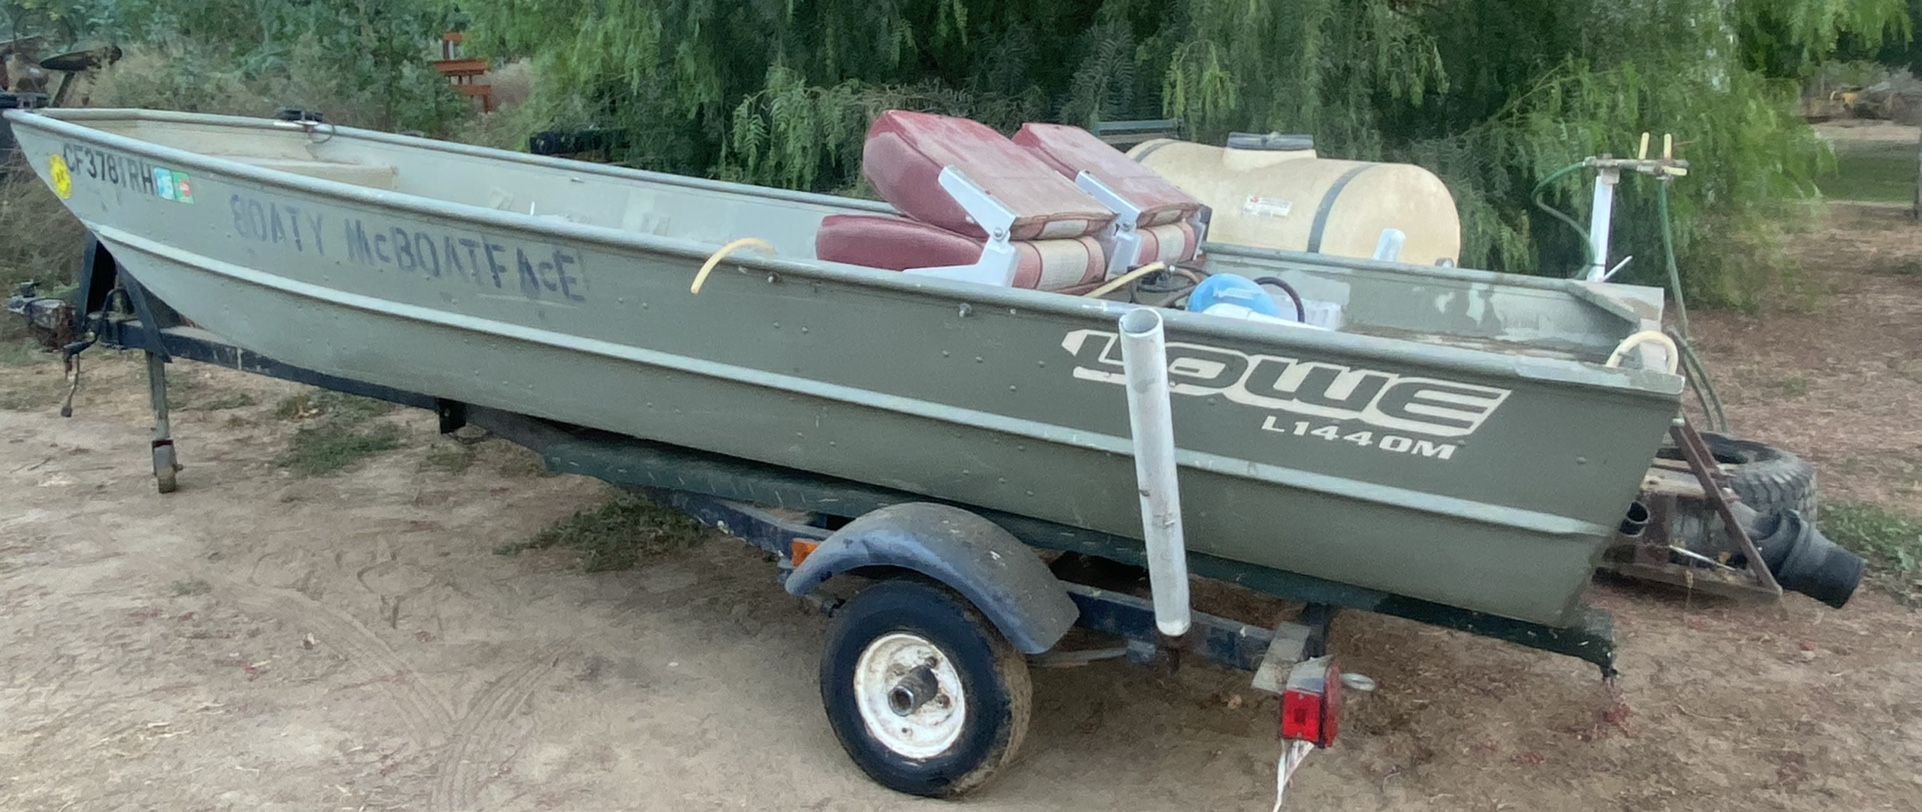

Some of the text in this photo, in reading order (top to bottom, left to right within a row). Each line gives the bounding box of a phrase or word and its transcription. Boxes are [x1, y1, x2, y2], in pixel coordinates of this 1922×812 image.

[231, 194, 324, 256] BOATY
[1061, 329, 1511, 437] LOWE
[1261, 415, 1457, 460] L1440M
